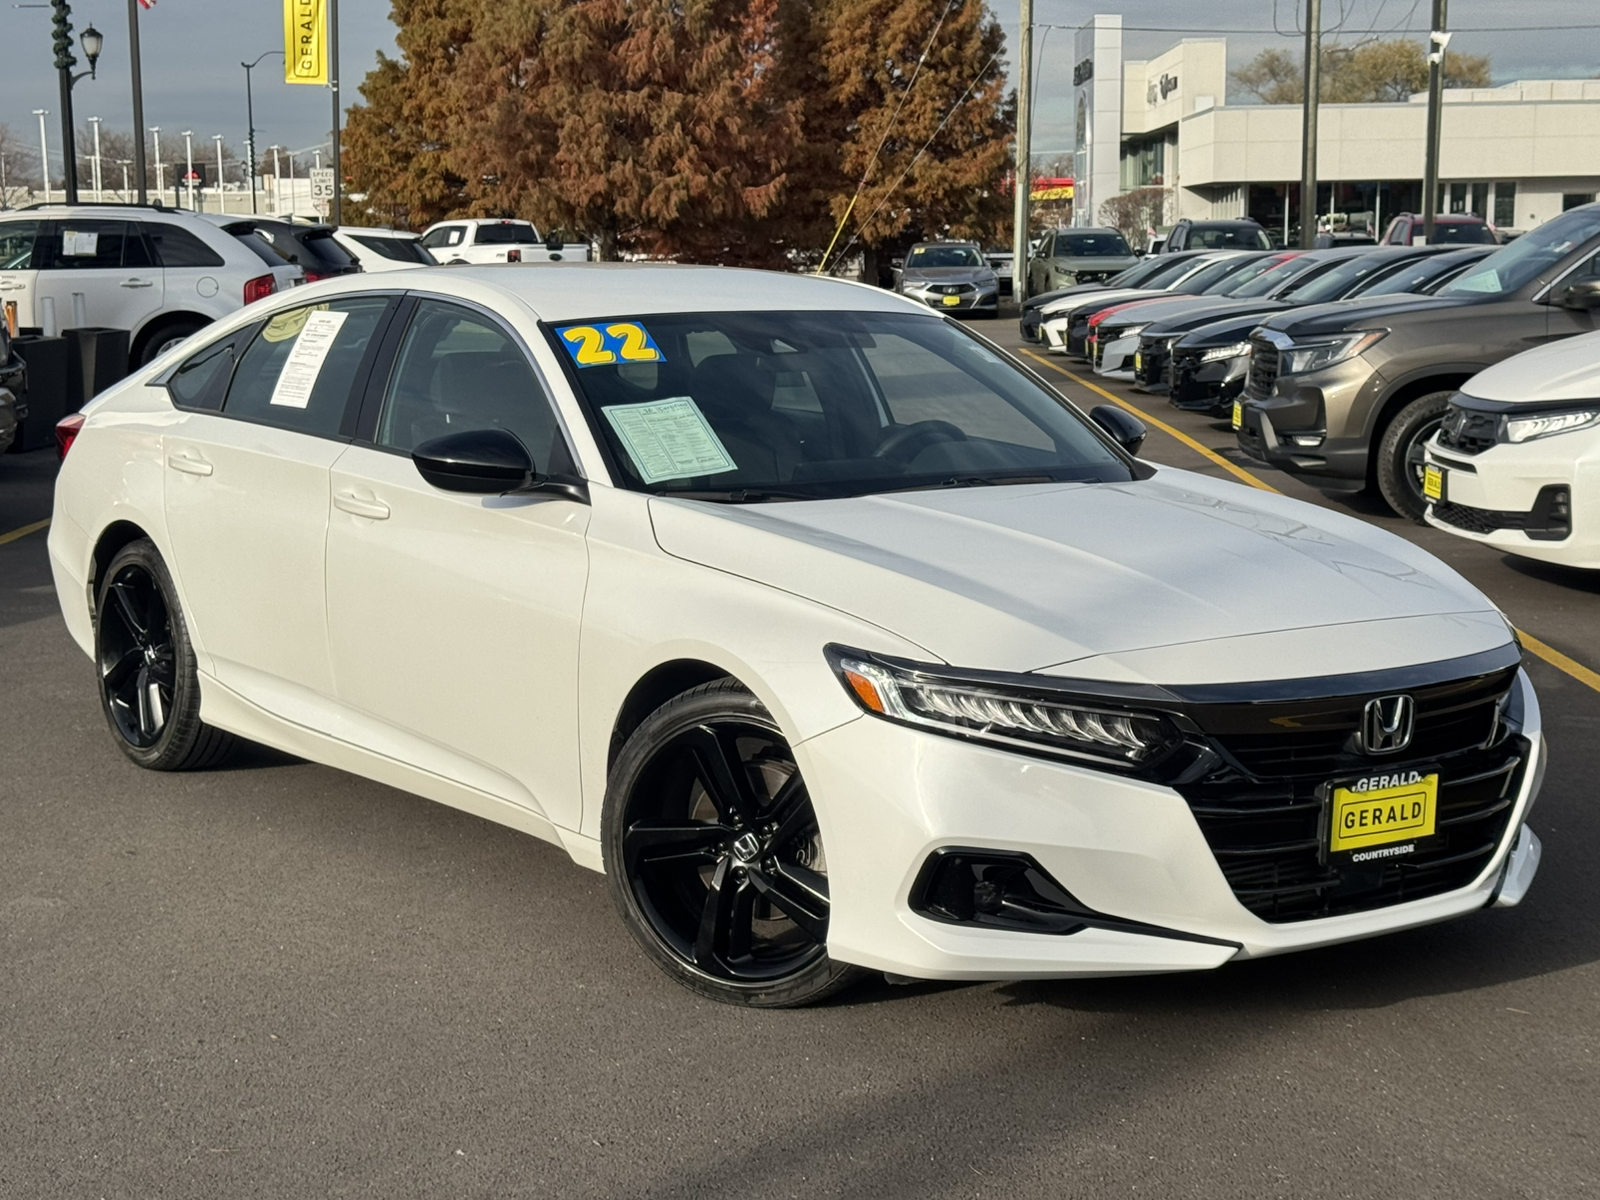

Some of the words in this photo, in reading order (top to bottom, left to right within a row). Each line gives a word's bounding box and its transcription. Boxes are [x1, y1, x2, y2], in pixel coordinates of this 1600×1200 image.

[314, 184, 334, 196] 35
[563, 324, 660, 364] 22
[1356, 771, 1419, 792] GERALD
[1344, 802, 1422, 829] GERALD
[1352, 844, 1415, 862] COUNTRYSIDE
